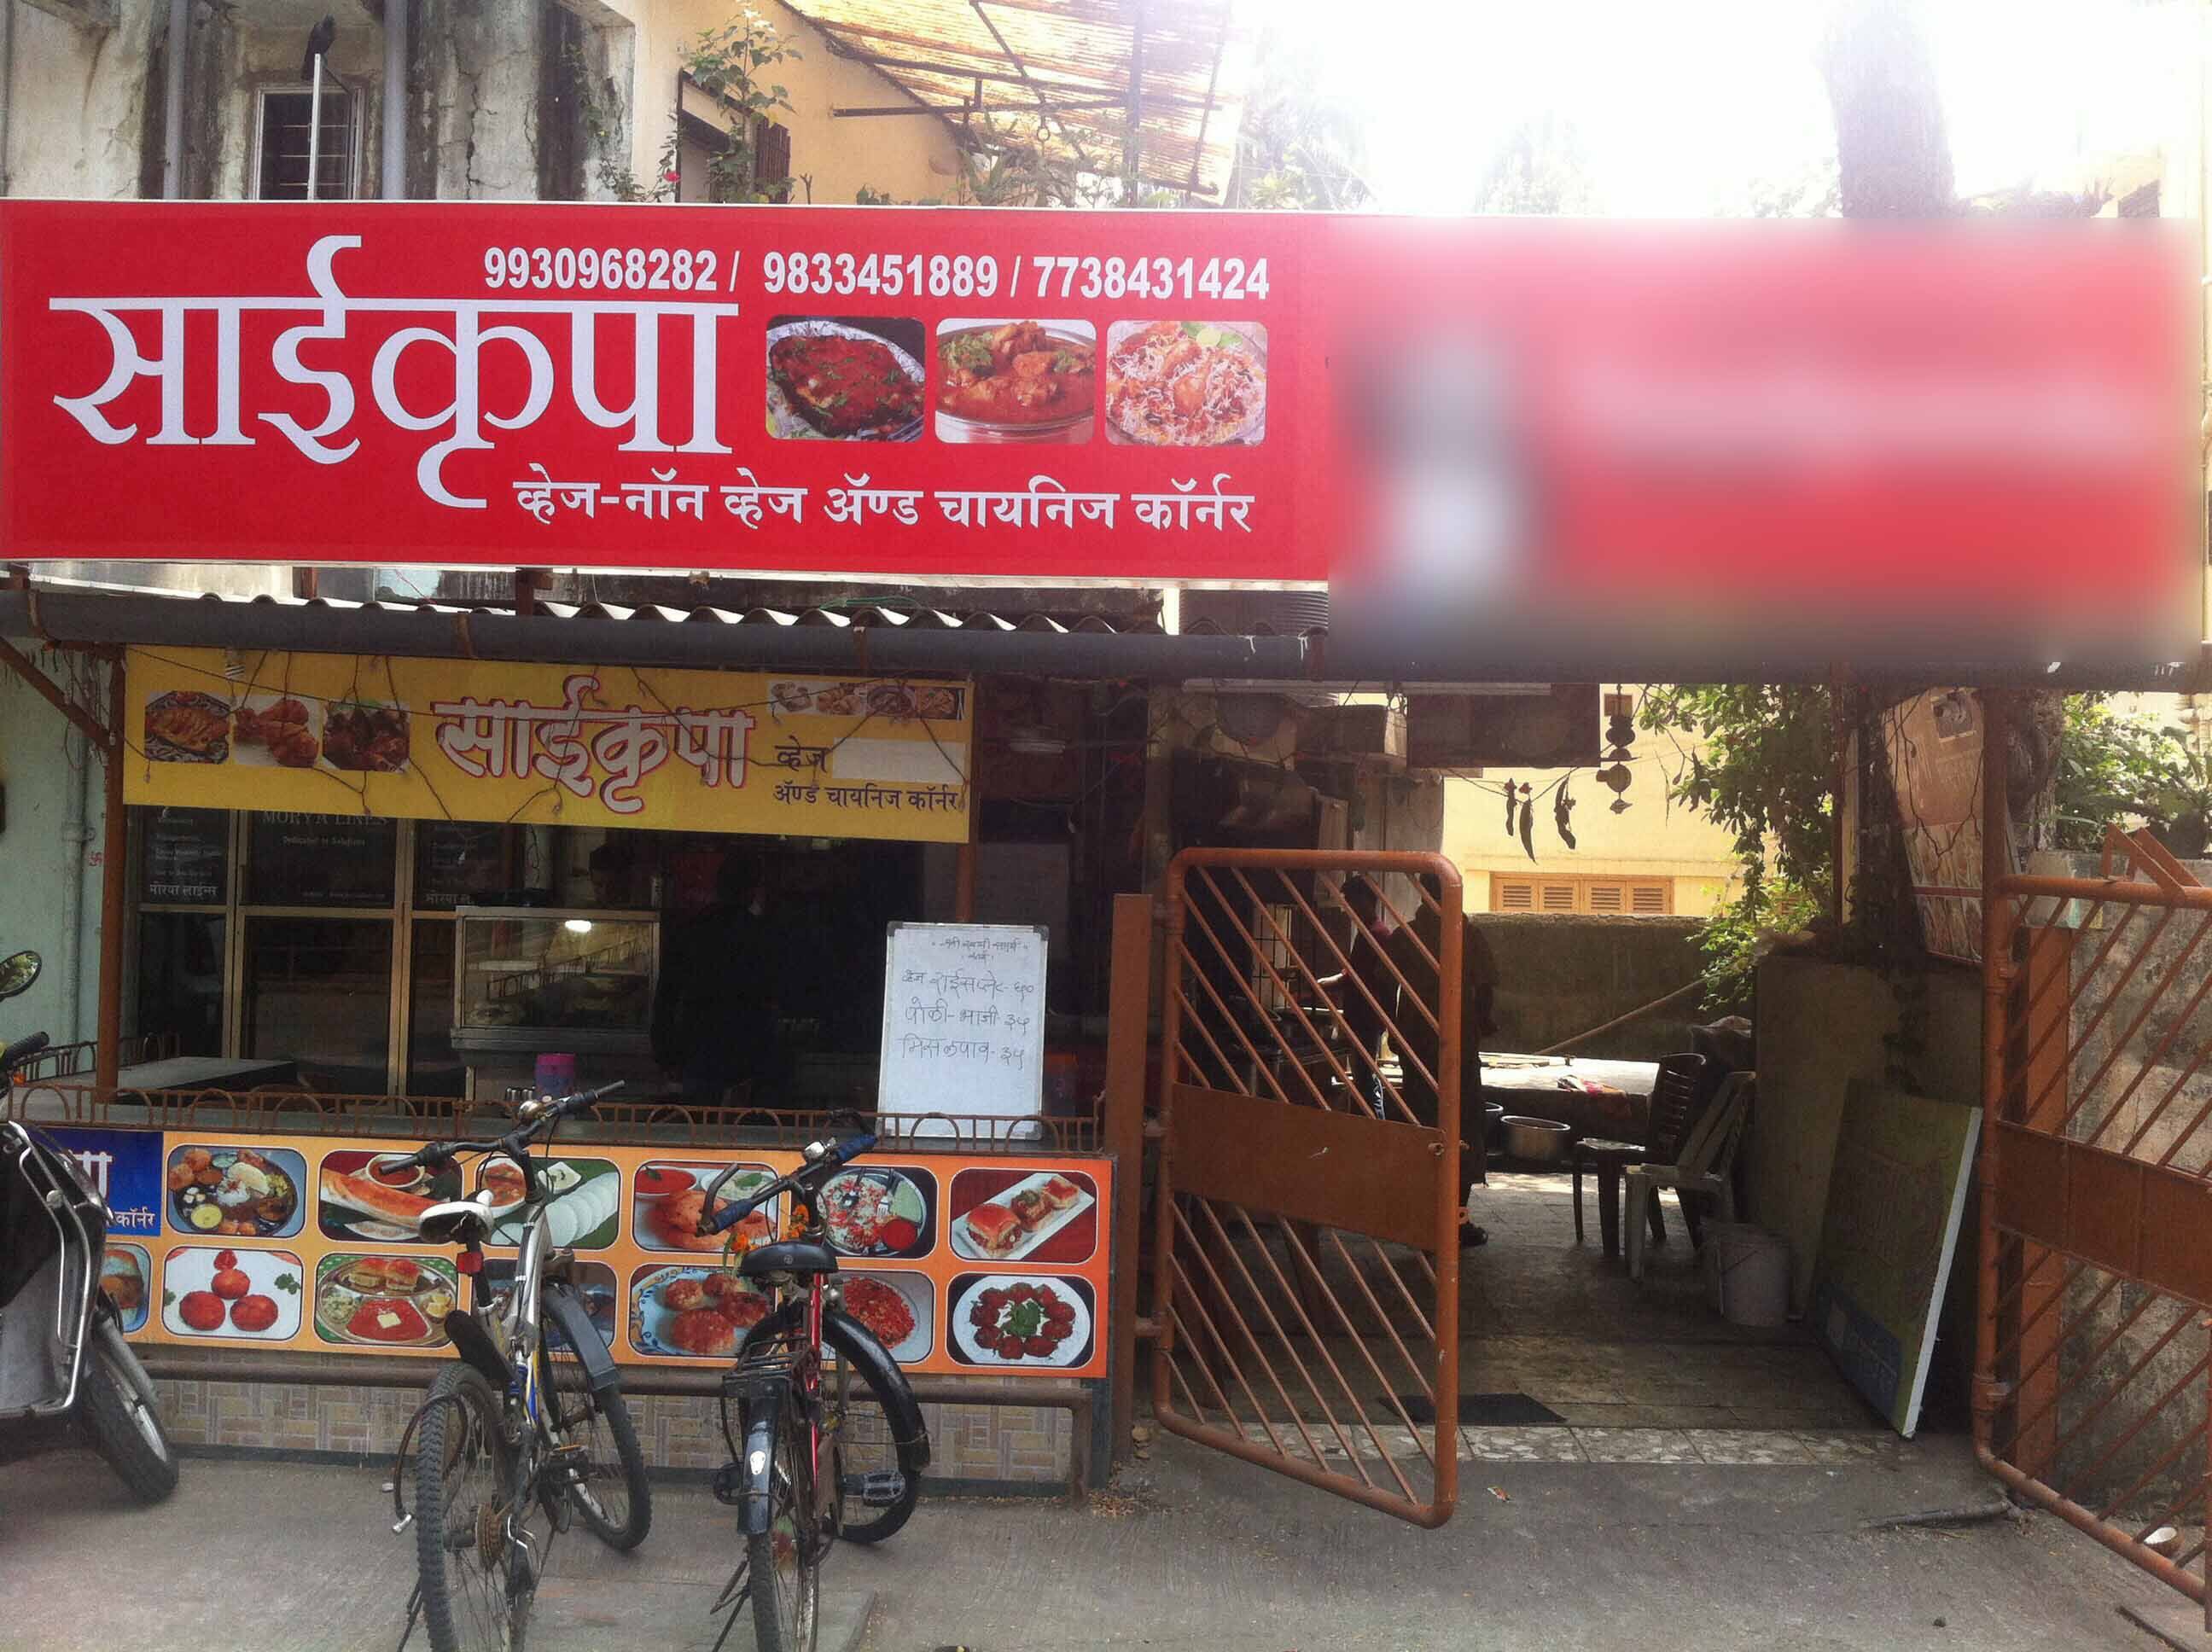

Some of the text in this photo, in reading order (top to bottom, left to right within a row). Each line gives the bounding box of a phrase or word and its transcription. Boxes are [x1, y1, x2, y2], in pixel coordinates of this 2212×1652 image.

[484, 247, 718, 291] 9930968282
[764, 251, 998, 298] 9833451889
[1033, 256, 1270, 300] 7738431424
[49, 235, 739, 509] साईकृपा
[513, 463, 709, 524] व्हेज-नॉन
[720, 467, 808, 530] व्हेज
[935, 474, 1121, 530] चायनिज
[1132, 474, 1256, 533] कॉर्नर
[430, 674, 756, 813] साईकृपा
[774, 735, 830, 774] व्हेज
[826, 782, 901, 811] चायनिज
[908, 784, 958, 811] कॉर्नर
[114, 1206, 155, 1229] कॉर्नर
